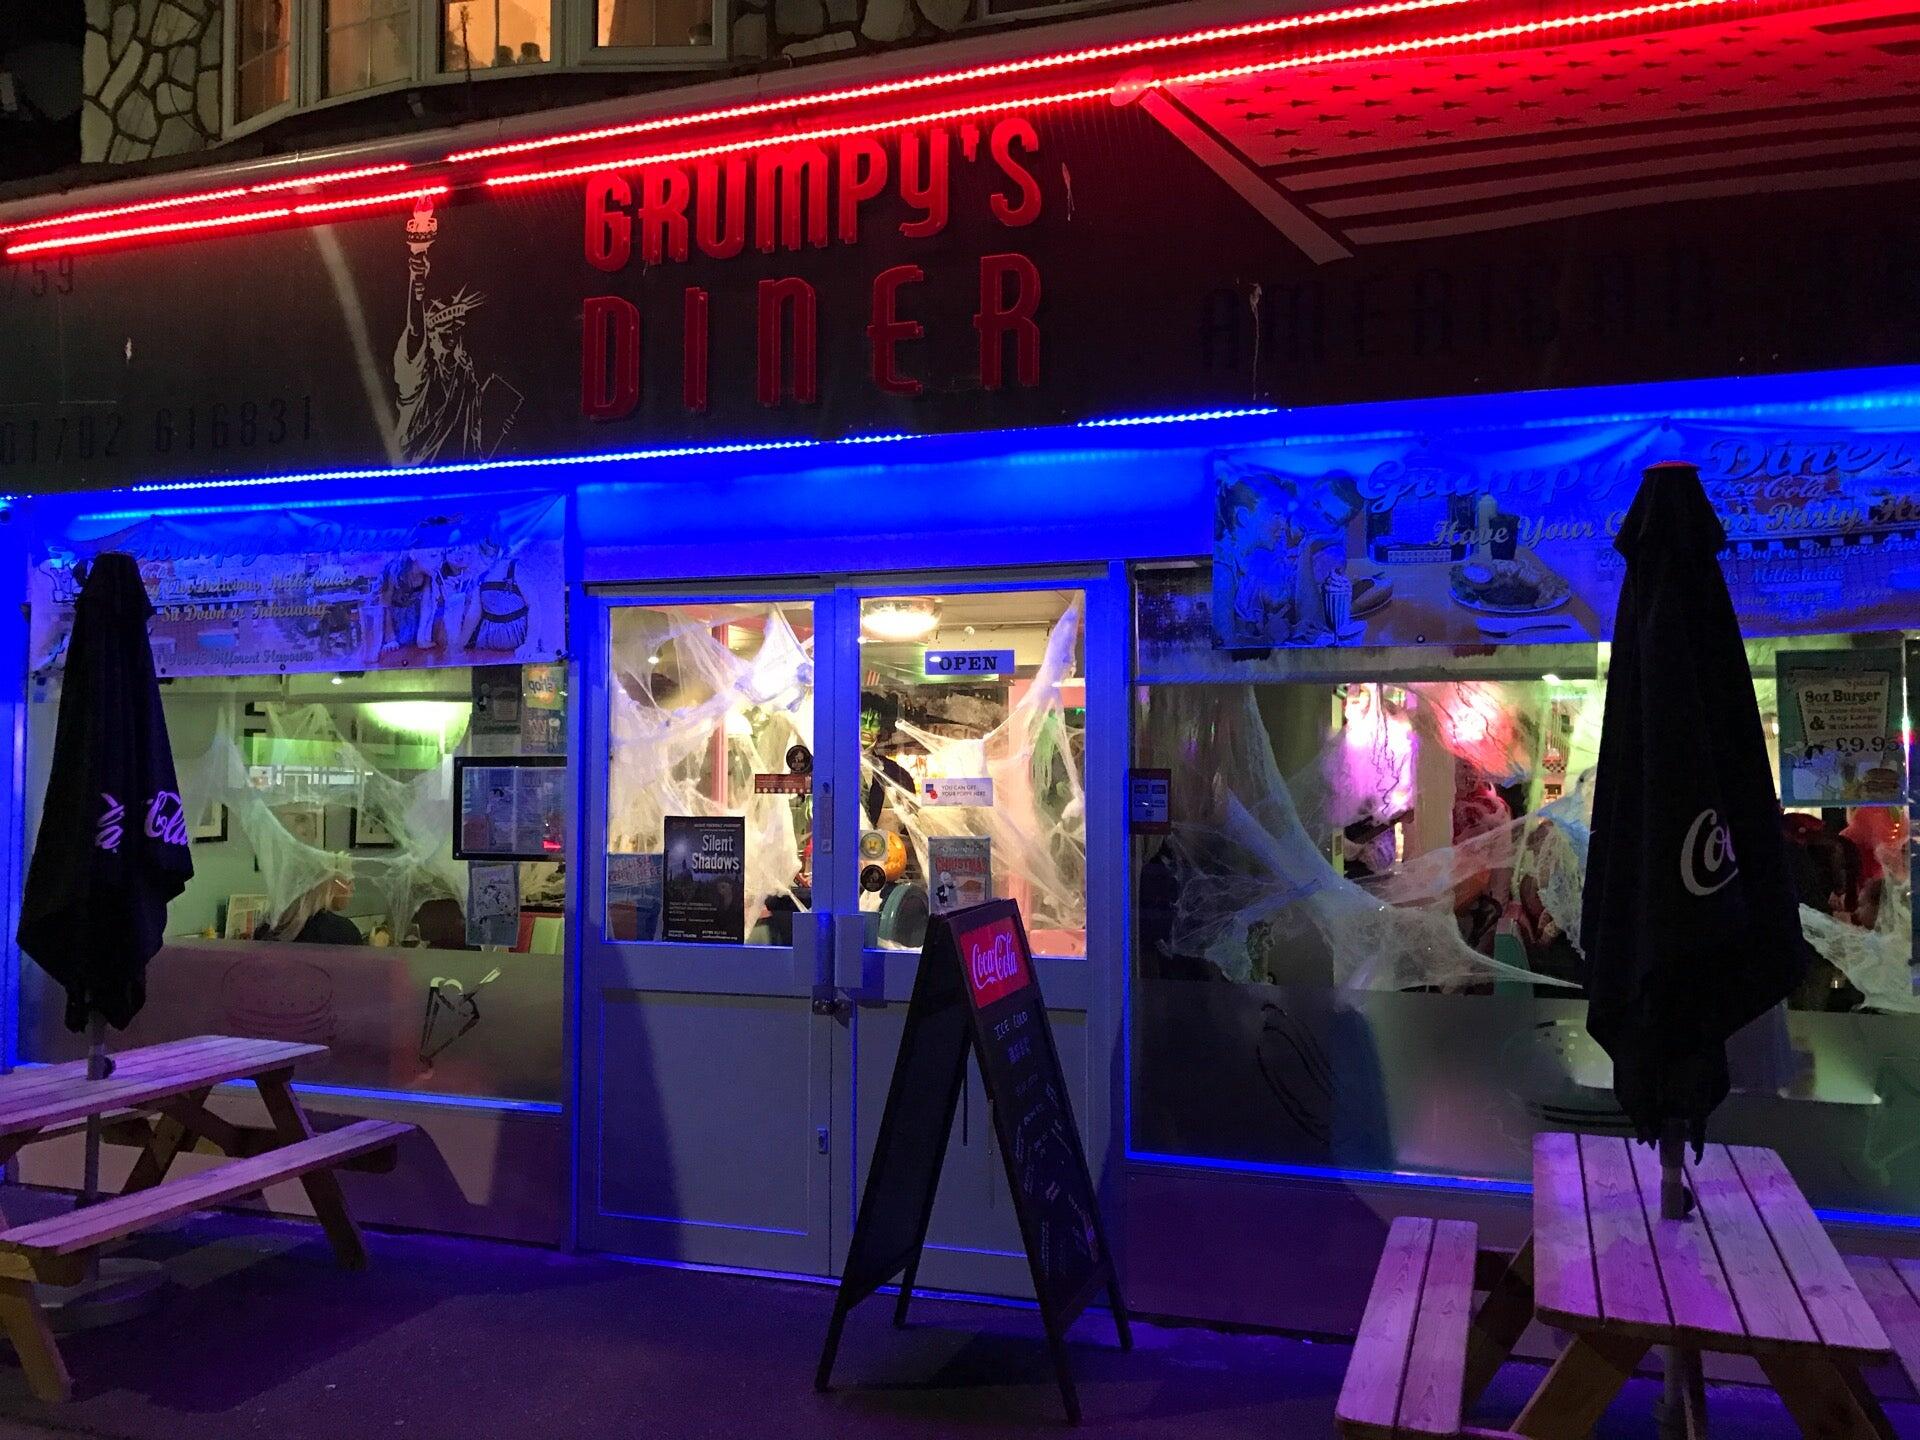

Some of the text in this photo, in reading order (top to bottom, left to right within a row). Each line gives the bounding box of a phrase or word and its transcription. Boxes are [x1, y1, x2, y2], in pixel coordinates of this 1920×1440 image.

[583, 116, 1043, 273] GRUMPY'S
[581, 252, 1043, 423] DINER
[154, 396, 316, 457] 616831
[1698, 437, 1914, 482] Diner
[1429, 518, 1510, 547] Have
[1517, 512, 1598, 551] Your
[1766, 501, 1862, 536] Party
[186, 604, 226, 622] Down
[939, 655, 999, 673] OPEN
[1832, 689, 1881, 705] Burger
[701, 834, 734, 852] Silent
[691, 852, 741, 871] Shadows
